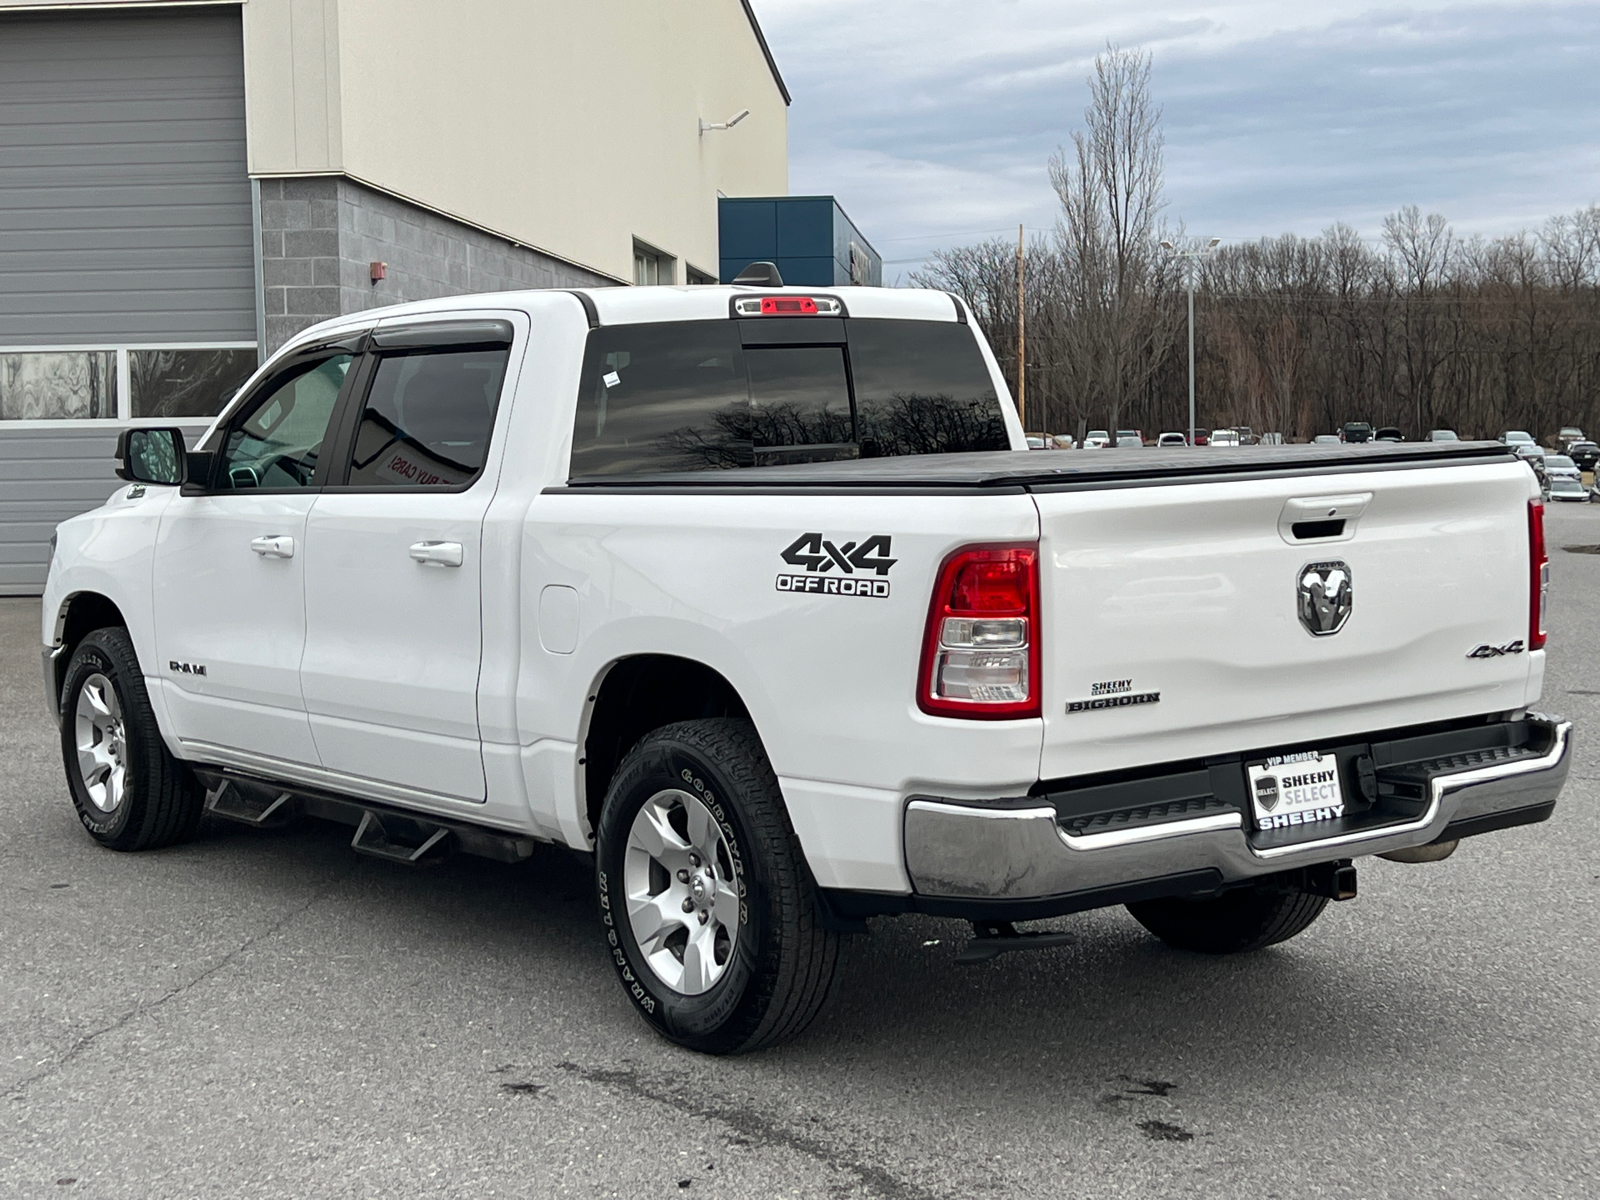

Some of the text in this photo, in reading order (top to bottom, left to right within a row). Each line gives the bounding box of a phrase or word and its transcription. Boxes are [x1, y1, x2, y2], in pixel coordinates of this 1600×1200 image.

[776, 575, 890, 597] OFF ROAD
[169, 660, 207, 677] RAM
[1091, 679, 1132, 692] SHEEHY
[1065, 692, 1160, 714] BIGHORN
[1266, 750, 1319, 767] VIP MEMBER
[1282, 769, 1335, 789] SHEEHY
[1256, 787, 1278, 796] SELECT
[1284, 783, 1337, 805] SELECT
[1259, 804, 1345, 831] SHEEHY
[681, 768, 748, 926] GOODYEAR
[599, 871, 656, 1014] WRANGLER
